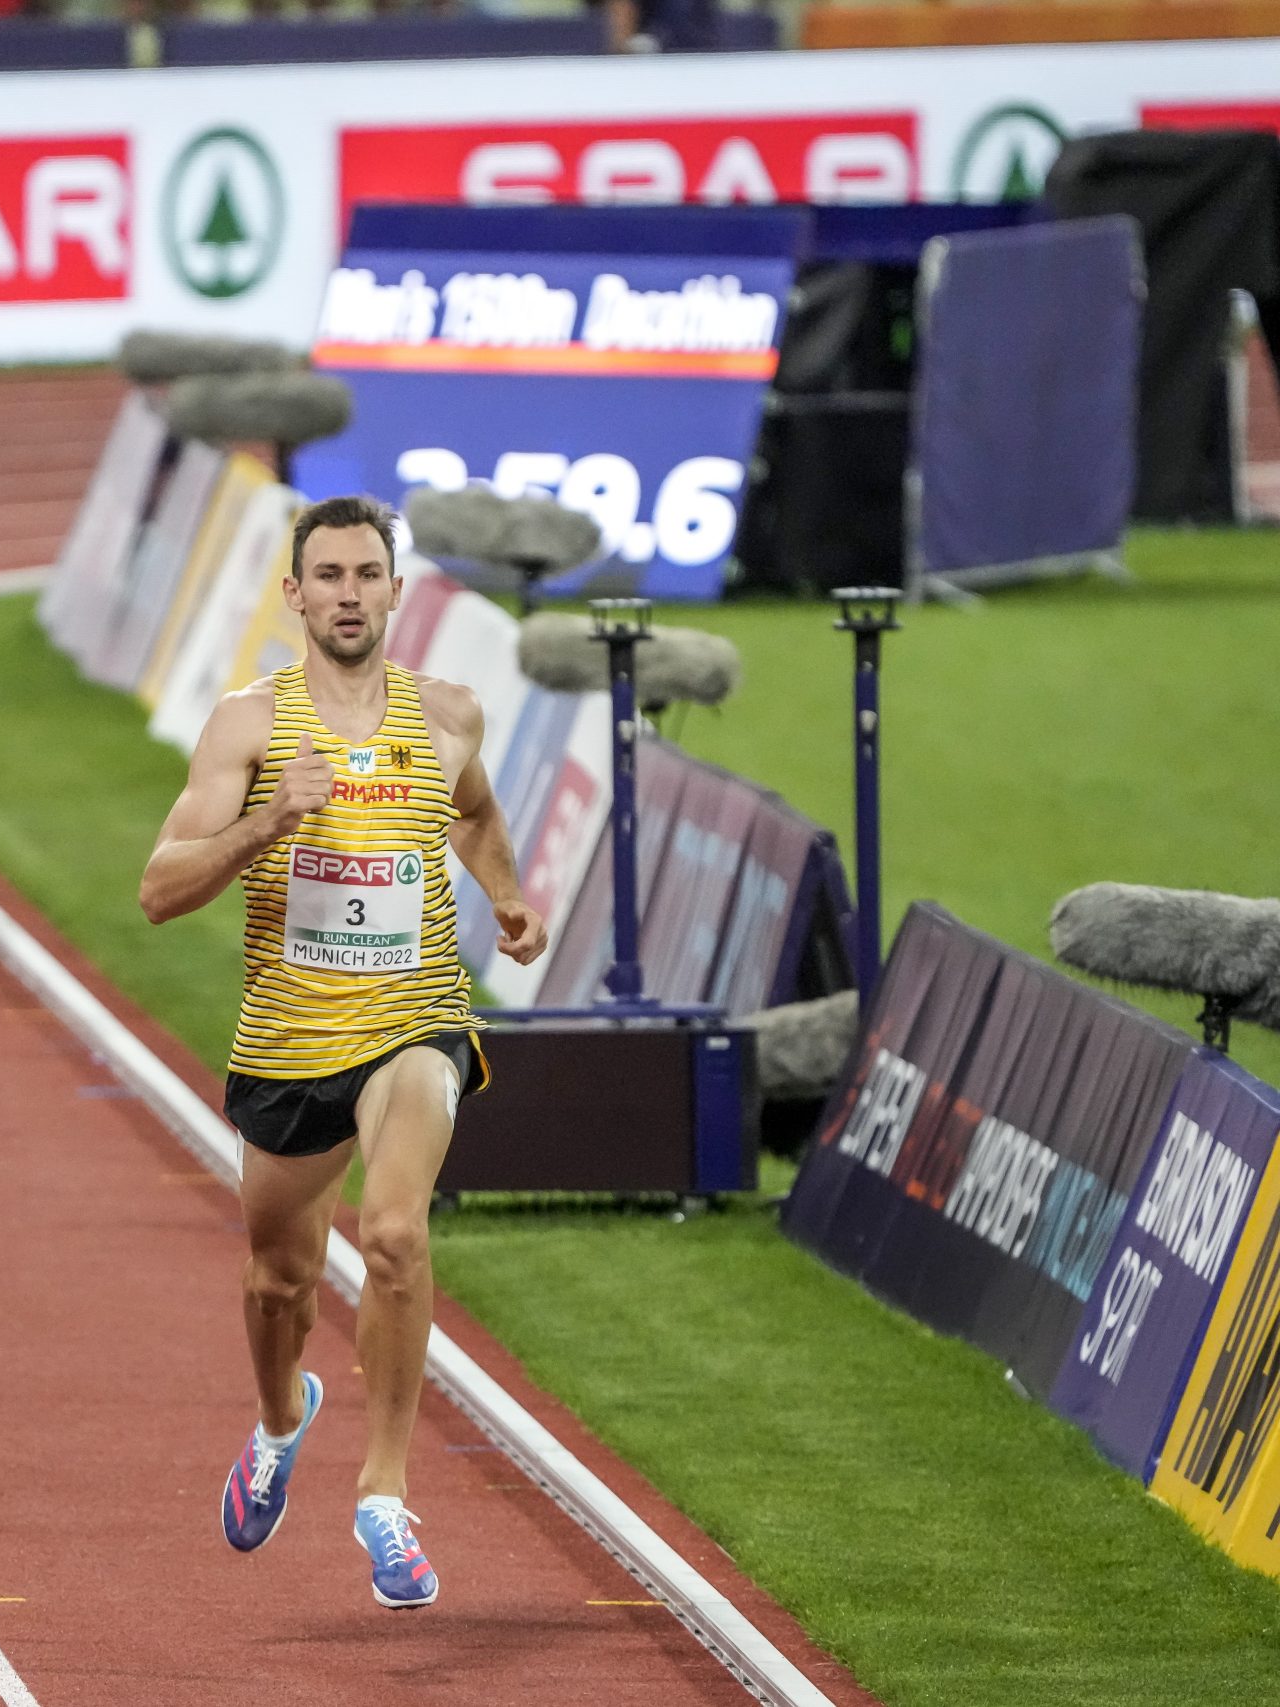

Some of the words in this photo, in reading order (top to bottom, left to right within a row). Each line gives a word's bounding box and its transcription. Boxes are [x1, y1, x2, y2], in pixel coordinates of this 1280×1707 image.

[331, 780, 413, 804] RMANY
[296, 852, 392, 883] SPAR
[345, 898, 366, 927] 3
[323, 933, 349, 945] RUN
[293, 943, 366, 967] MUNICH
[372, 948, 413, 967] 2022
